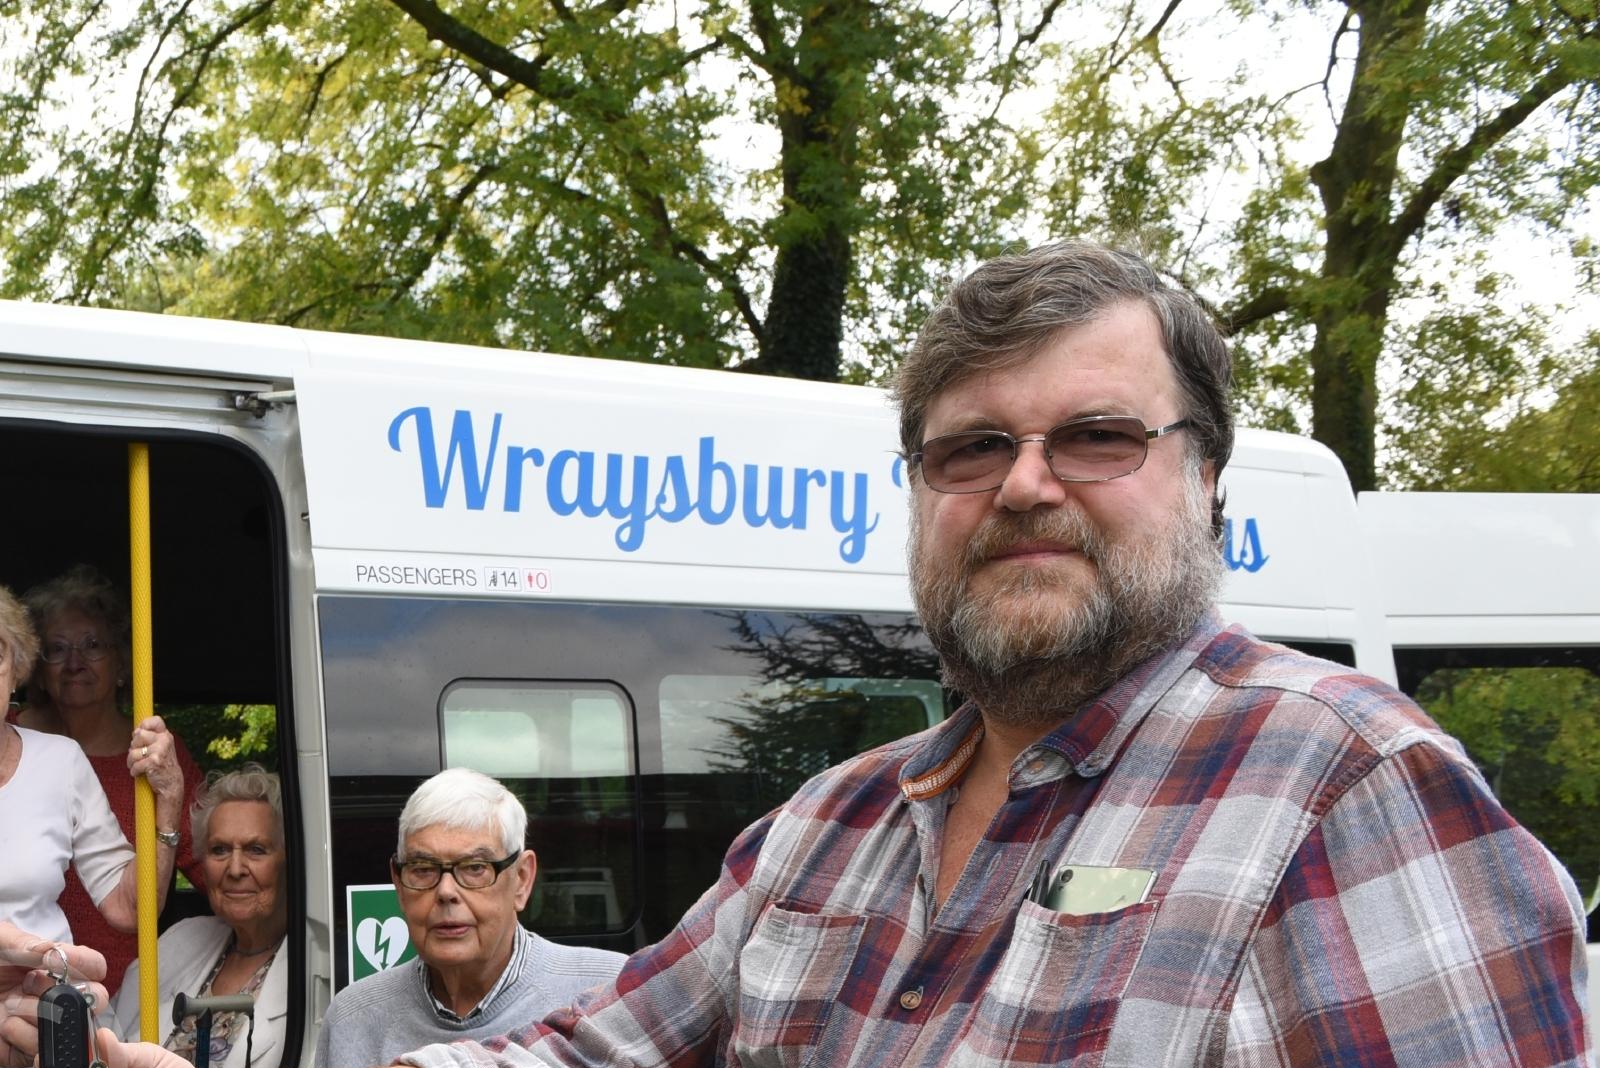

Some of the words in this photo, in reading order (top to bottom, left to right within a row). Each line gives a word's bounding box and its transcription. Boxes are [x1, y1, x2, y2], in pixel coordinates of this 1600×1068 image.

[388, 406, 880, 564] Wraysbury
[356, 565, 478, 587] PASSENGERS
[500, 570, 518, 588] 14
